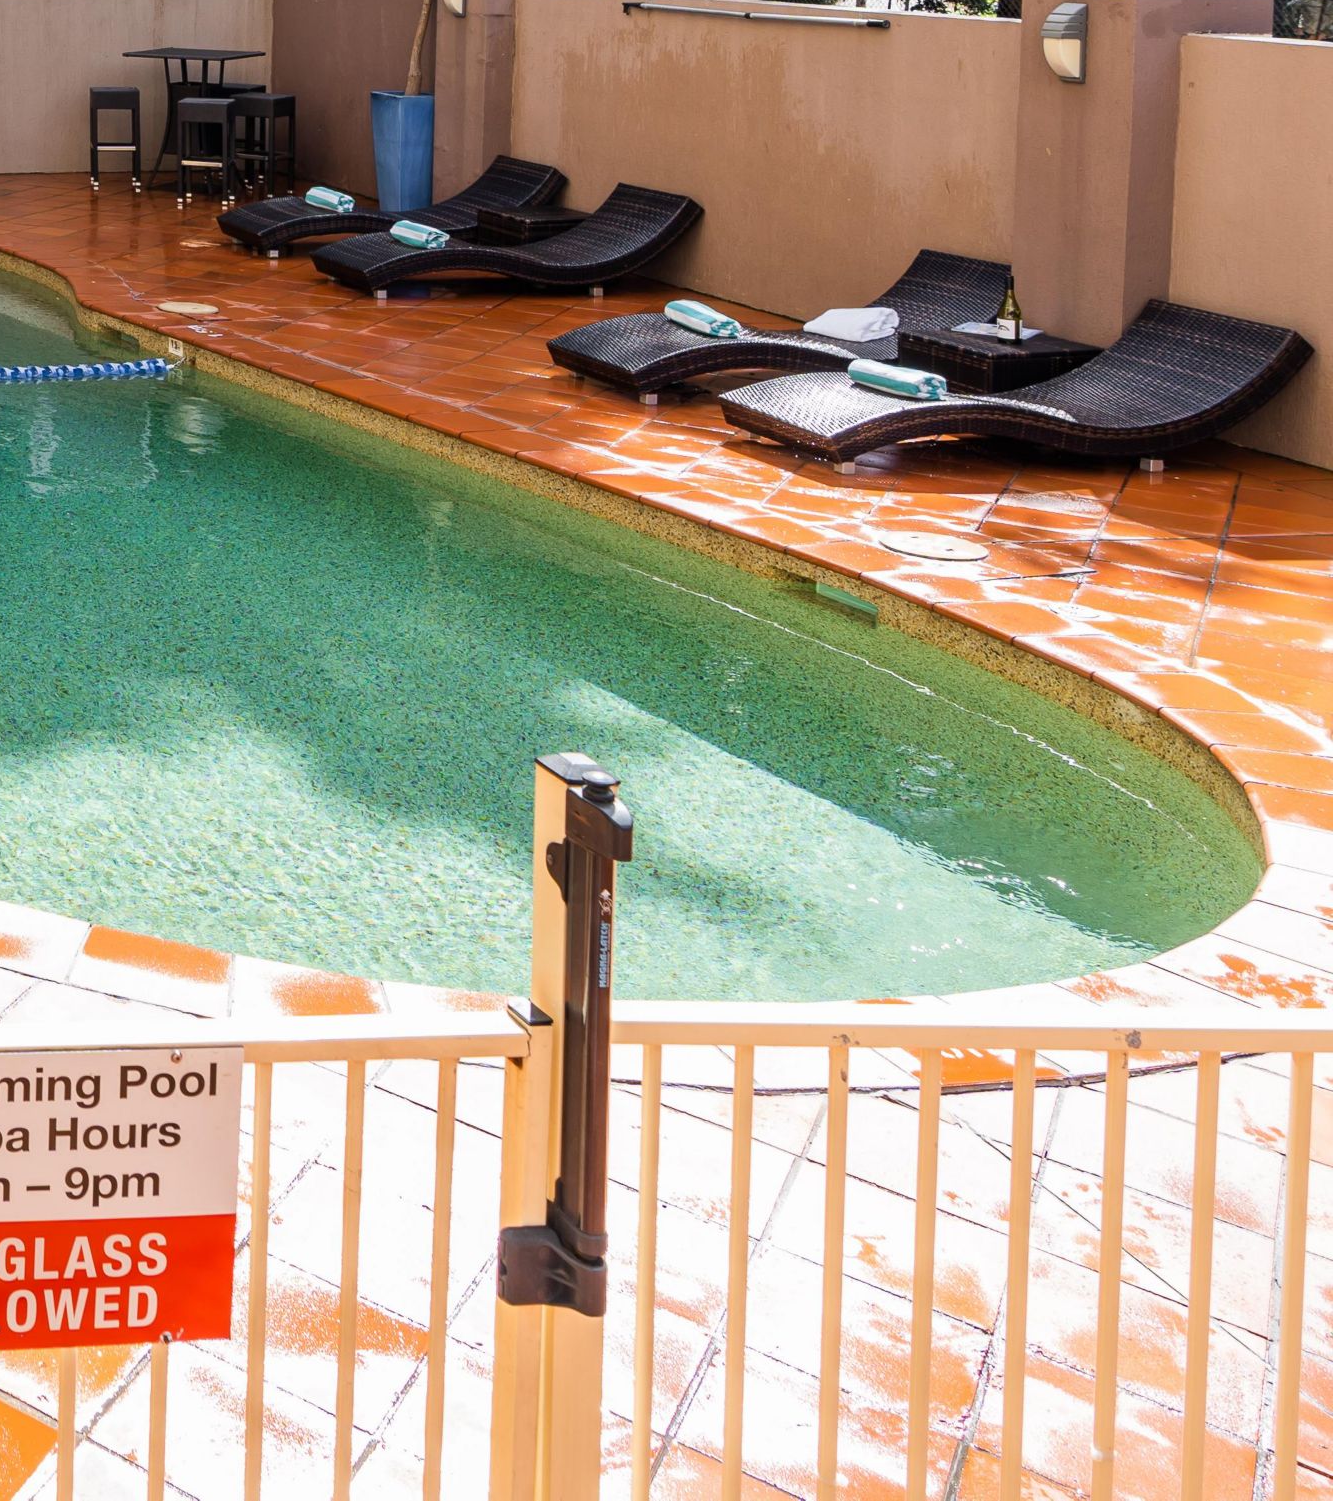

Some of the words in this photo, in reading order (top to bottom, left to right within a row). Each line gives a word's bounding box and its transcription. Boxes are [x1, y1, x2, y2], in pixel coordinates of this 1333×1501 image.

[119, 1062, 218, 1099] Pool
[48, 1116, 181, 1151] Hours
[64, 1167, 161, 1207] 9pm
